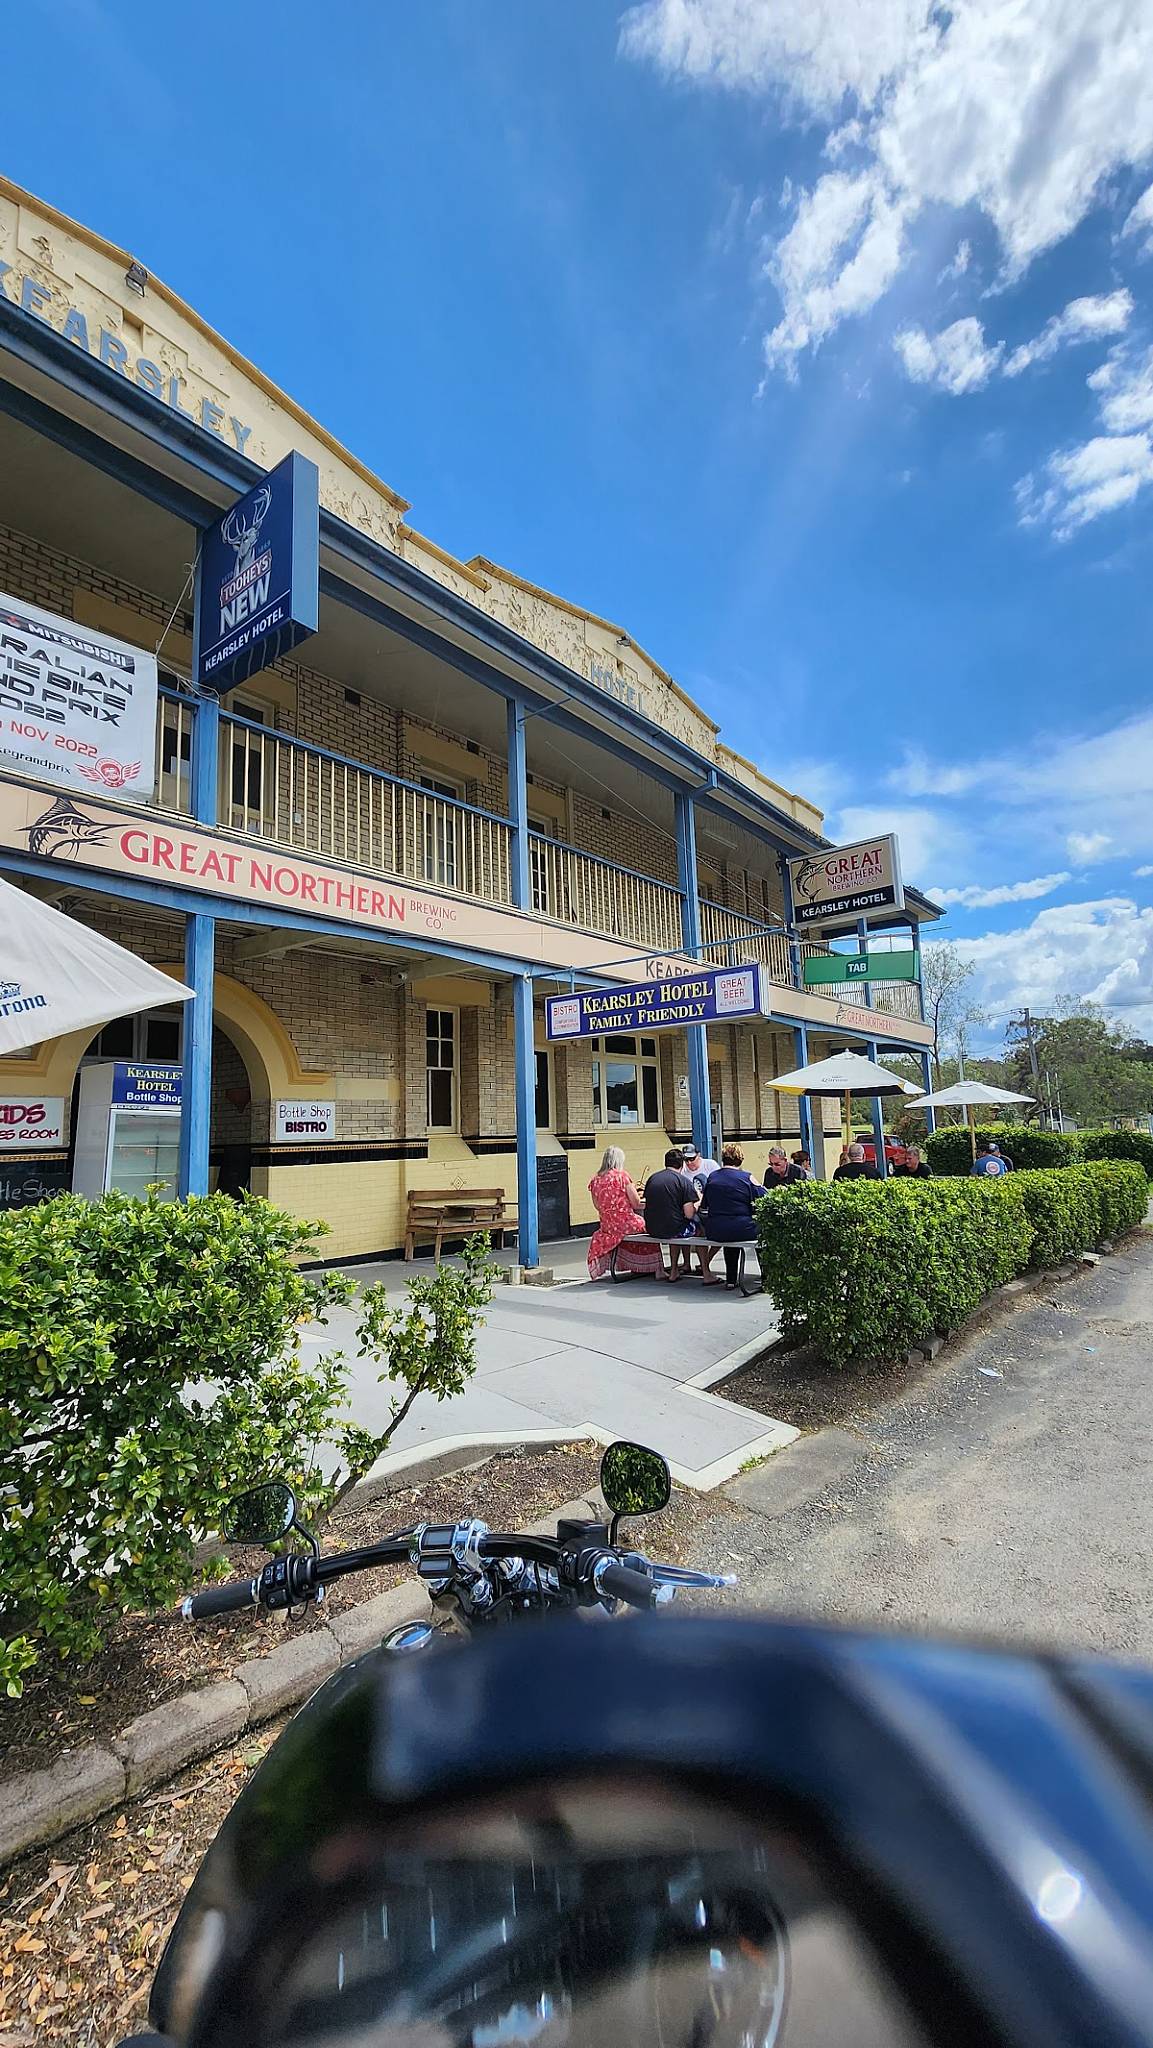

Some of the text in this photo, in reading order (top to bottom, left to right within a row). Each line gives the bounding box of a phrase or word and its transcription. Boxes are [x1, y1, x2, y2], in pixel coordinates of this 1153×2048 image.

[221, 555, 269, 600] TOOHEYS
[219, 571, 271, 636] NEW
[28, 623, 126, 667] MITSUBISHI
[205, 606, 284, 671] KEARSLEY HOTEL
[47, 670, 126, 711] BIKE
[591, 660, 649, 718] HOTEL
[42, 688, 121, 728] PRIX
[11, 720, 98, 759] NOV 2022
[825, 848, 882, 876] GREAT
[827, 864, 883, 886] NORTHERN
[119, 829, 457, 922] GREAT NORTHERN BREWING
[832, 880, 864, 892] BREWING
[802, 892, 887, 918] KEARSLEY HOTEL
[425, 916, 444, 930] CO.
[847, 963, 867, 973] TAB
[720, 976, 747, 989] GREAT
[724, 988, 745, 999] BEER
[553, 1004, 577, 1016] BISTRO
[582, 980, 713, 1014] KEARSLEY HOTEL
[589, 1012, 633, 1030] FAMILY
[637, 1002, 706, 1024] FRIENDLY
[126, 1092, 156, 1102] Bottle
[136, 1080, 176, 1092] HOTEL
[279, 1104, 331, 1120] Bottle Shop
[19, 1128, 59, 1140] ROOM
[285, 1121, 327, 1133] BISTRO
